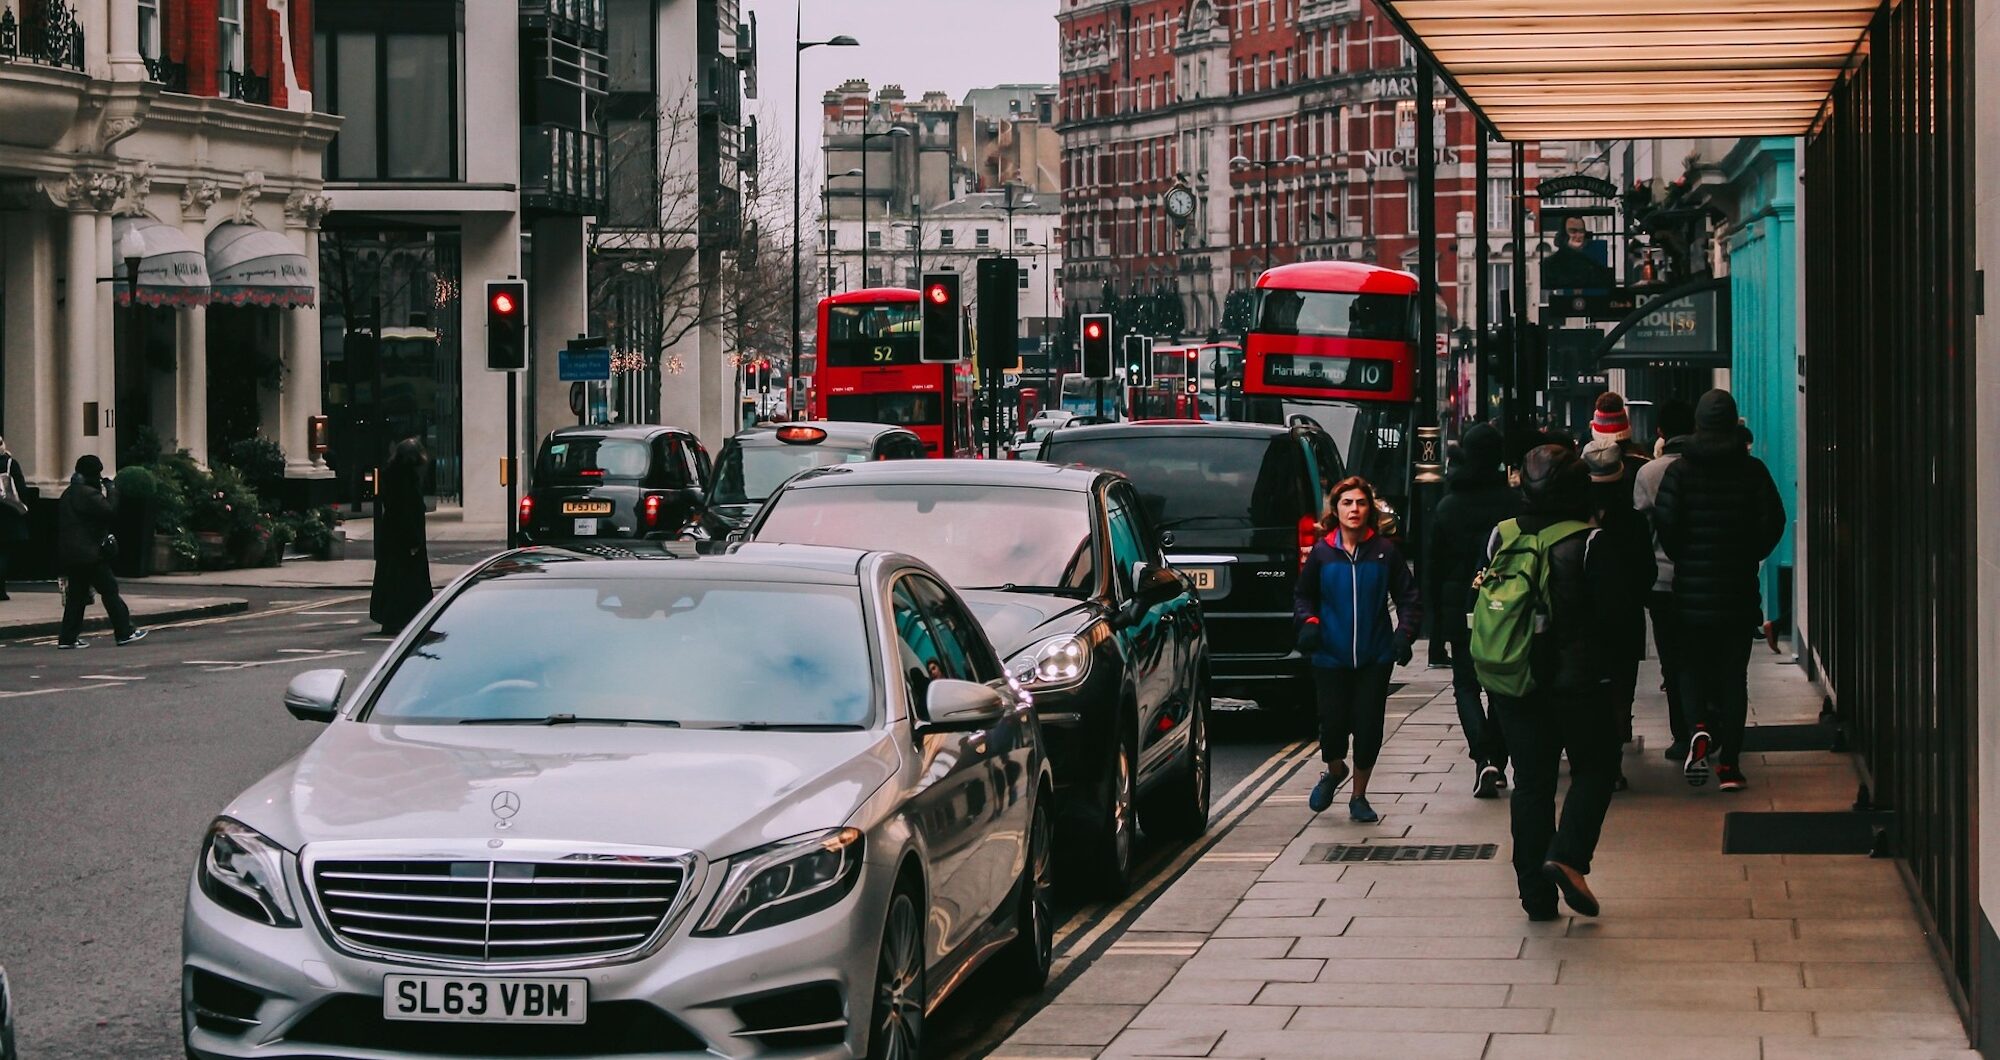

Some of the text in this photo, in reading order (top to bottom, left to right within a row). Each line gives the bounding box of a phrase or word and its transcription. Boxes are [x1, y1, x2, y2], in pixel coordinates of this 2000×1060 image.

[1371, 77, 1446, 97] HARV
[1364, 149, 1459, 169] NICHLS
[873, 345, 893, 361] 52
[1272, 363, 1380, 384] Hammersmith 10
[398, 980, 569, 1017] SL63 VBM
